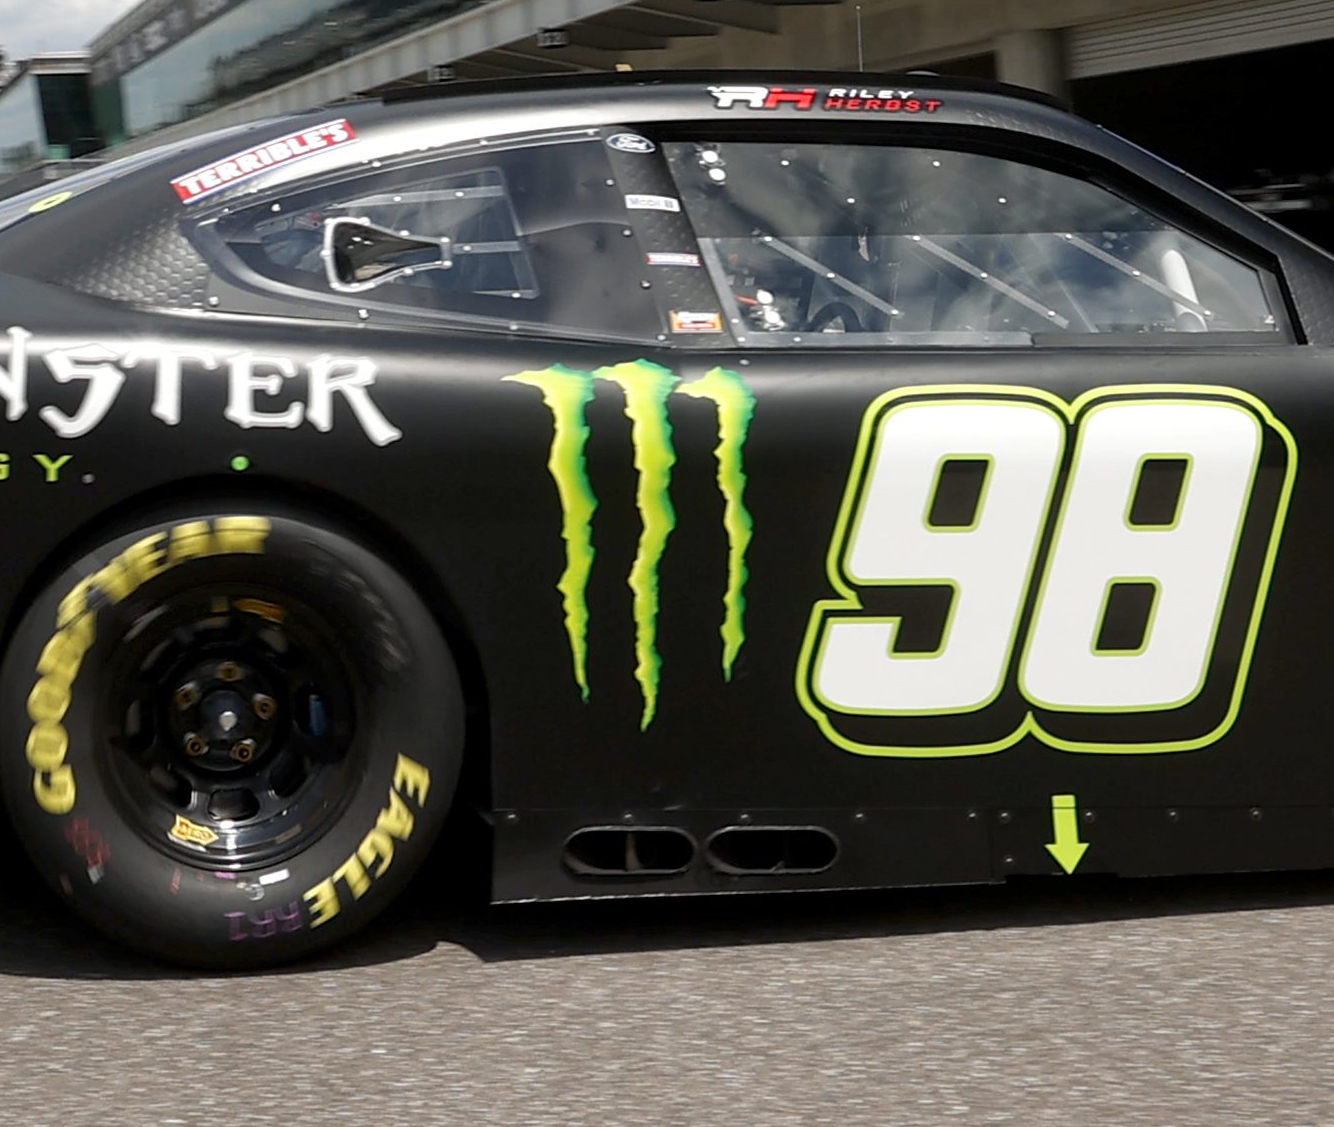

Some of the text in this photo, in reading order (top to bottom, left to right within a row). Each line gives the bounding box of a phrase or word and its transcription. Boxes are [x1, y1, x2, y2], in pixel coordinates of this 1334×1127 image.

[824, 98, 943, 113] HERBST
[828, 88, 916, 100] RILEY
[178, 124, 349, 196] TERRIBLE'S
[811, 398, 1265, 718] 98
[302, 751, 432, 930] EAGLE
